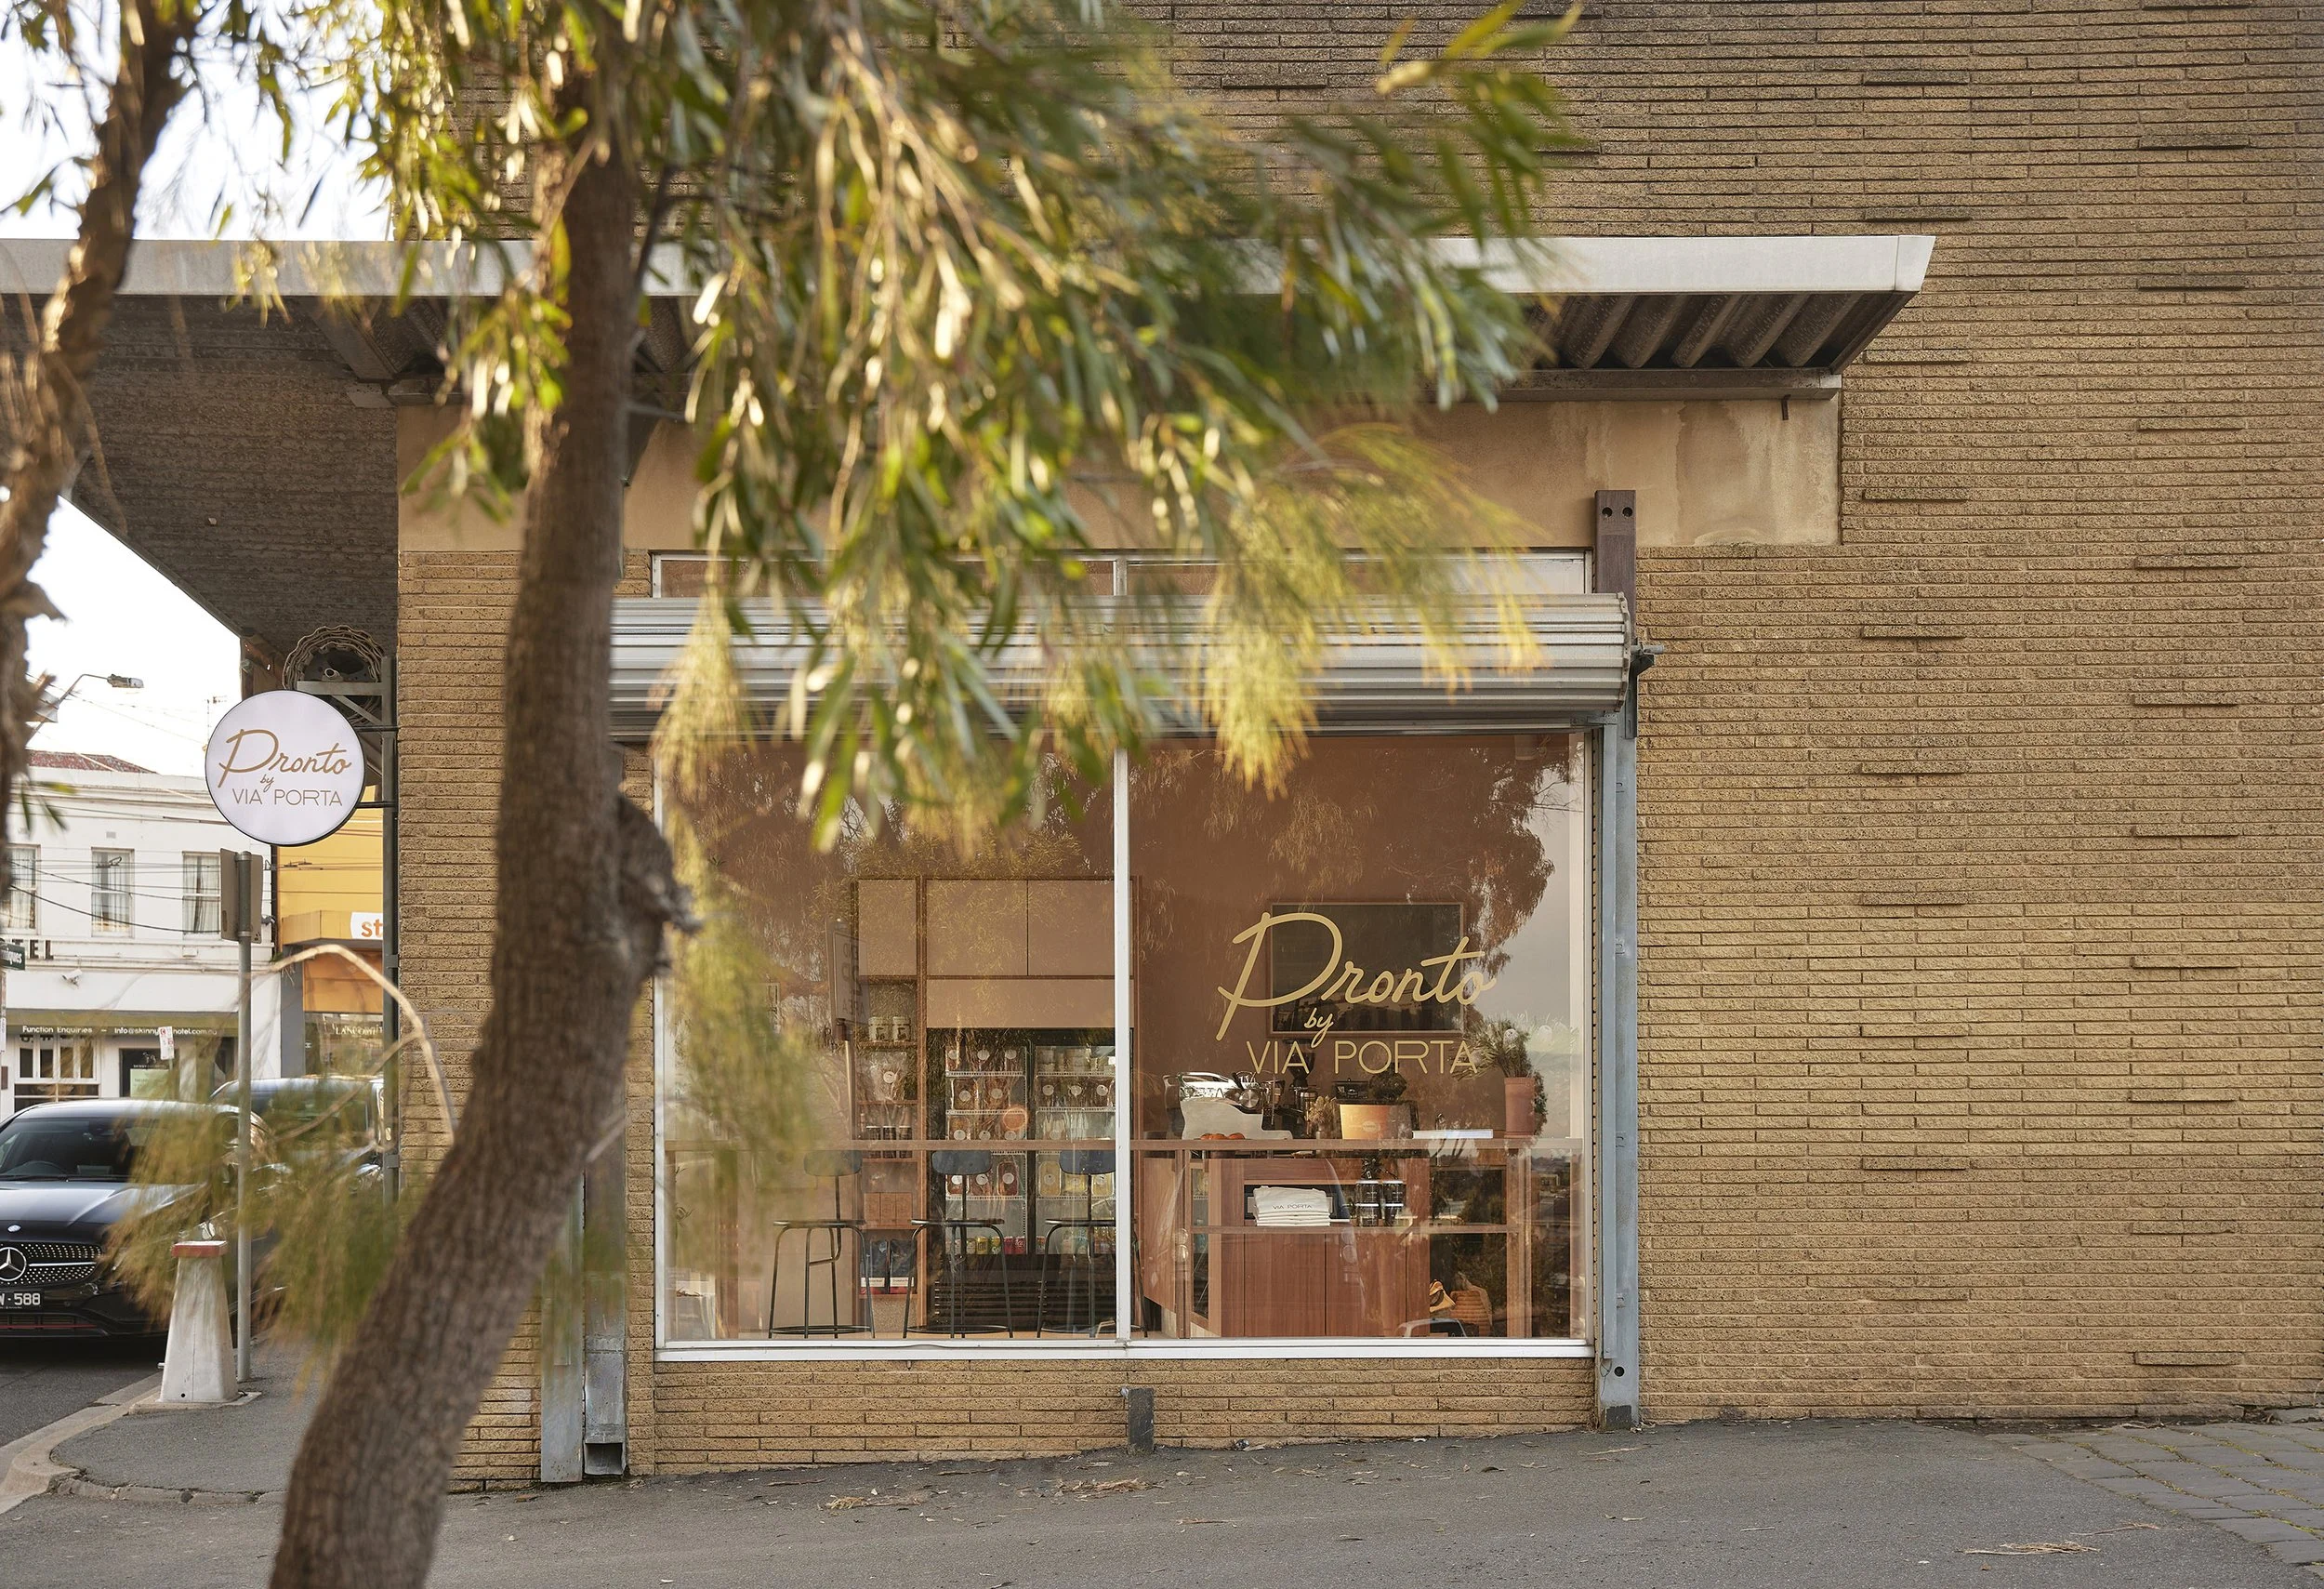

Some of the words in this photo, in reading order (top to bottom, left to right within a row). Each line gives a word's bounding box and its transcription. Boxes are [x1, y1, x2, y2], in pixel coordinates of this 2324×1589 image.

[218, 729, 352, 788] Pronto
[231, 788, 263, 805] VIA
[274, 788, 343, 806] PORTA
[259, 774, 274, 793] by
[1216, 911, 1497, 1041] Pronto
[22, 1026, 54, 1034] Function
[57, 1026, 93, 1035] Enquiries
[1303, 1007, 1334, 1049] by
[1246, 1040, 1310, 1075] VIA
[1334, 1040, 1478, 1075] PORTA
